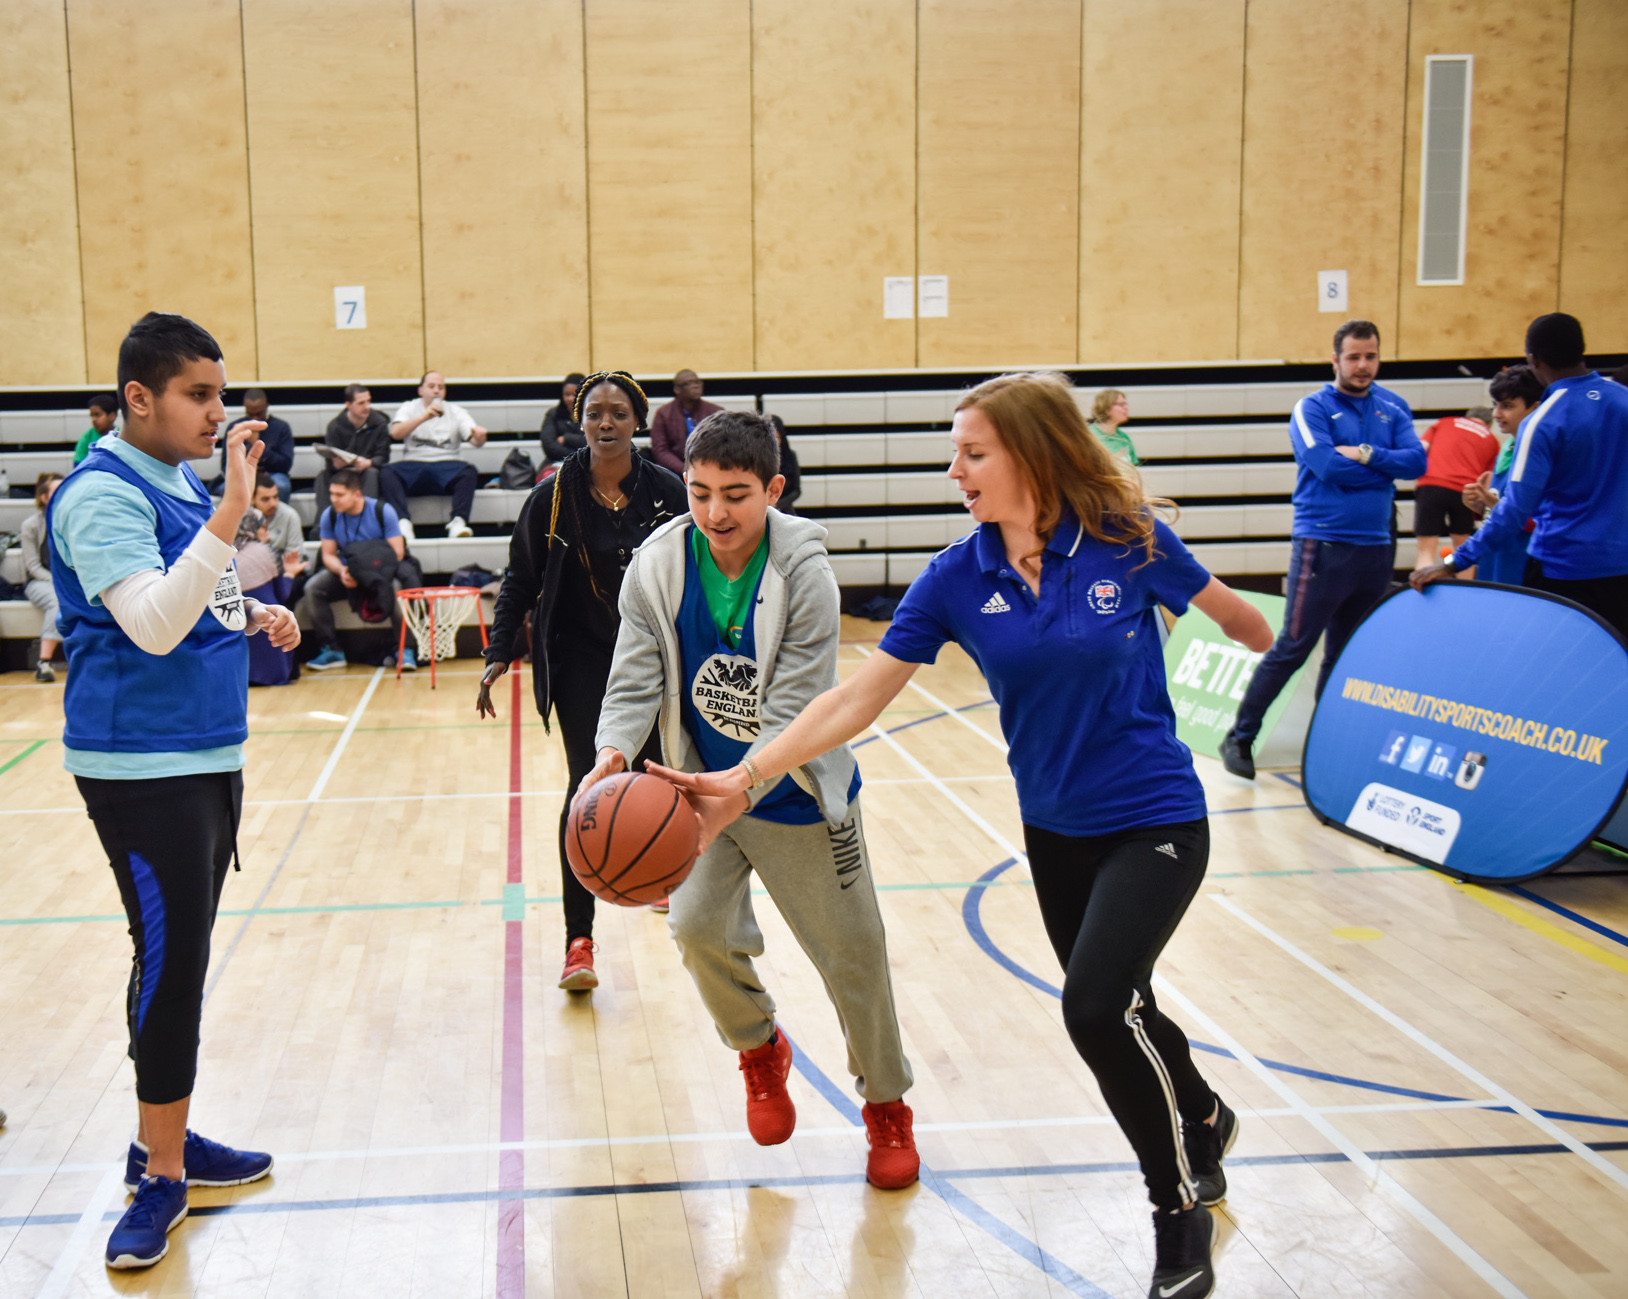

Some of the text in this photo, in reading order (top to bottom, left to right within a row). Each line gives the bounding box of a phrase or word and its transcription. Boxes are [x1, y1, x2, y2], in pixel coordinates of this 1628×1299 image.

[1327, 281, 1338, 299] 8
[343, 301, 357, 324] 7
[980, 604, 1011, 614] adidas
[1172, 638, 1264, 701] BETTE
[695, 687, 758, 707] BASKETBA
[706, 700, 758, 718] ENGLAN
[1342, 677, 1609, 765] WWW.DISABILITYSPORTSCOACH.CO.UK
[827, 817, 862, 876] NIKE
